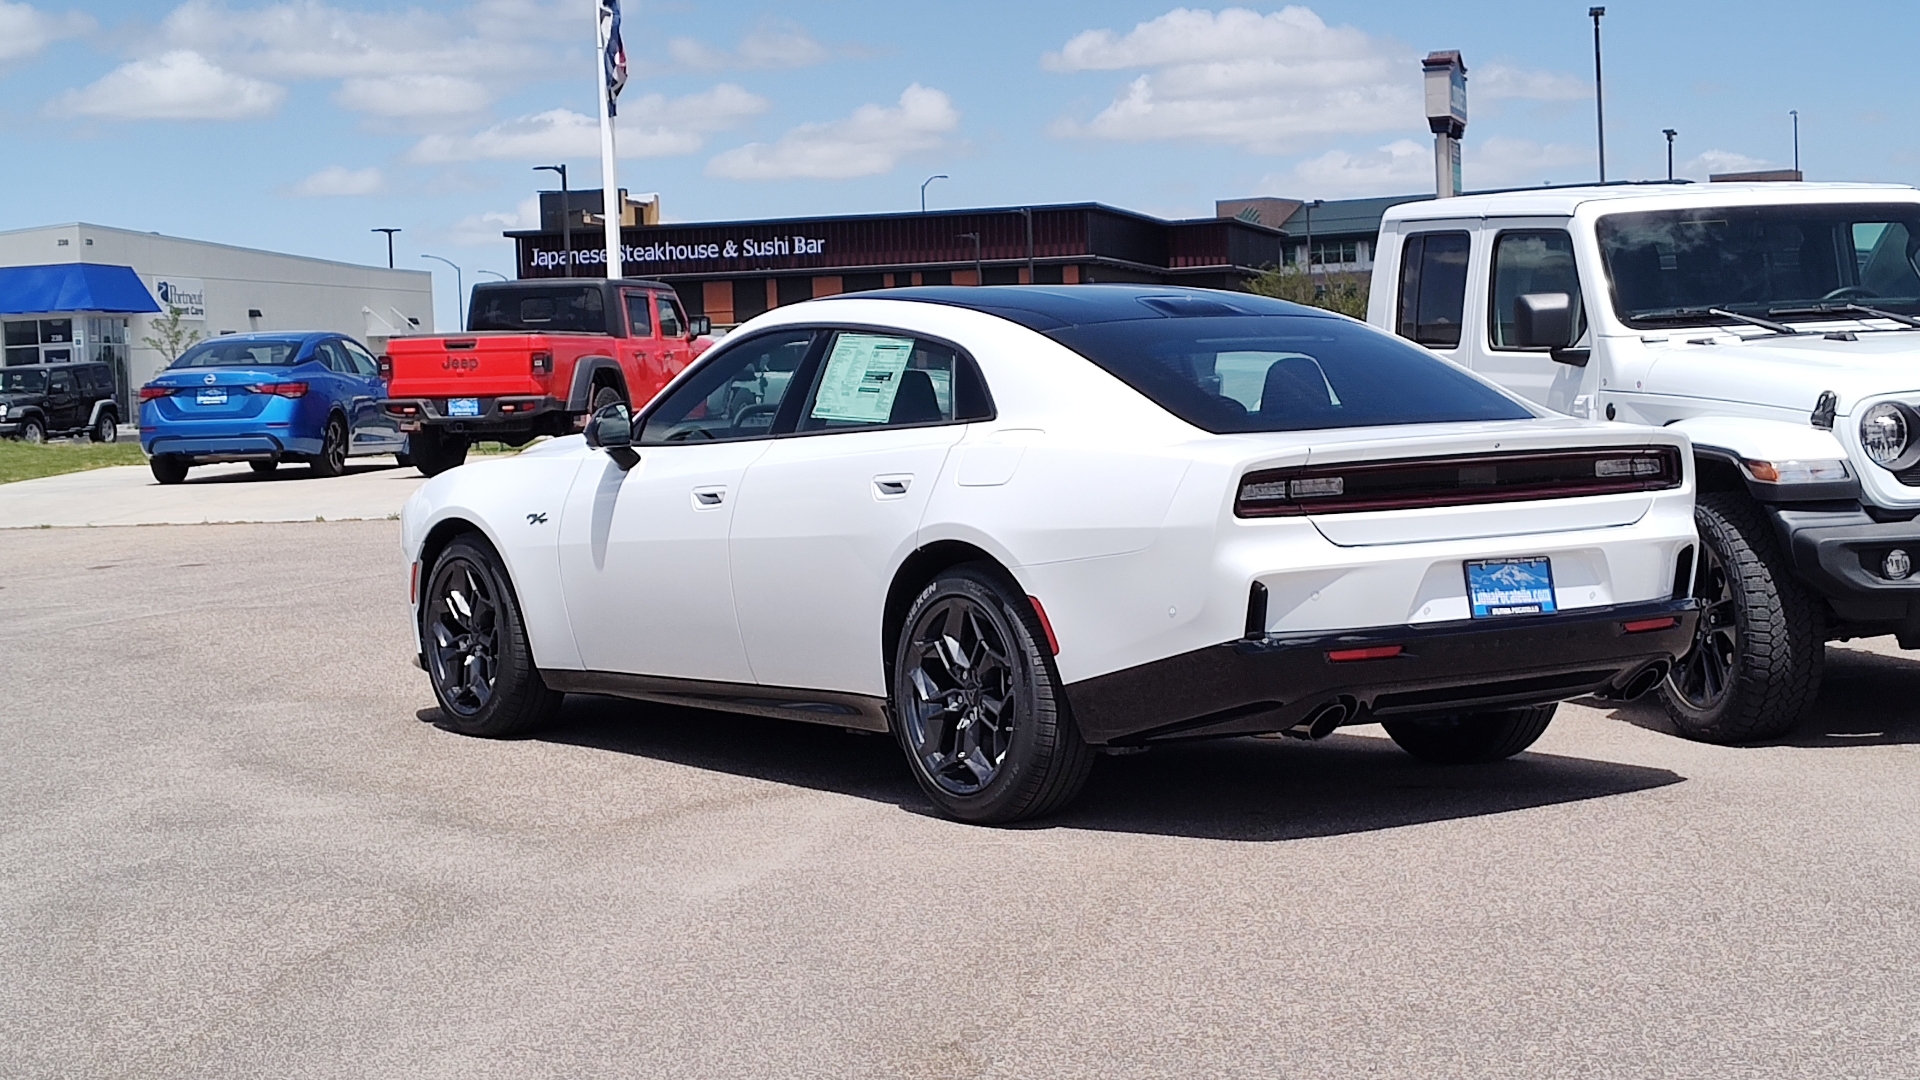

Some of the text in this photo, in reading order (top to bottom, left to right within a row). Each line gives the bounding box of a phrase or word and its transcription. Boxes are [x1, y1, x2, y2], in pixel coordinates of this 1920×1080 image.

[530, 247, 607, 270] Japanese
[723, 239, 739, 258] &
[742, 235, 789, 257] Sushi
[792, 235, 826, 255] Bar
[169, 284, 203, 305] Portneuf
[442, 355, 479, 371] Jeep
[906, 582, 937, 626] NEXEN
